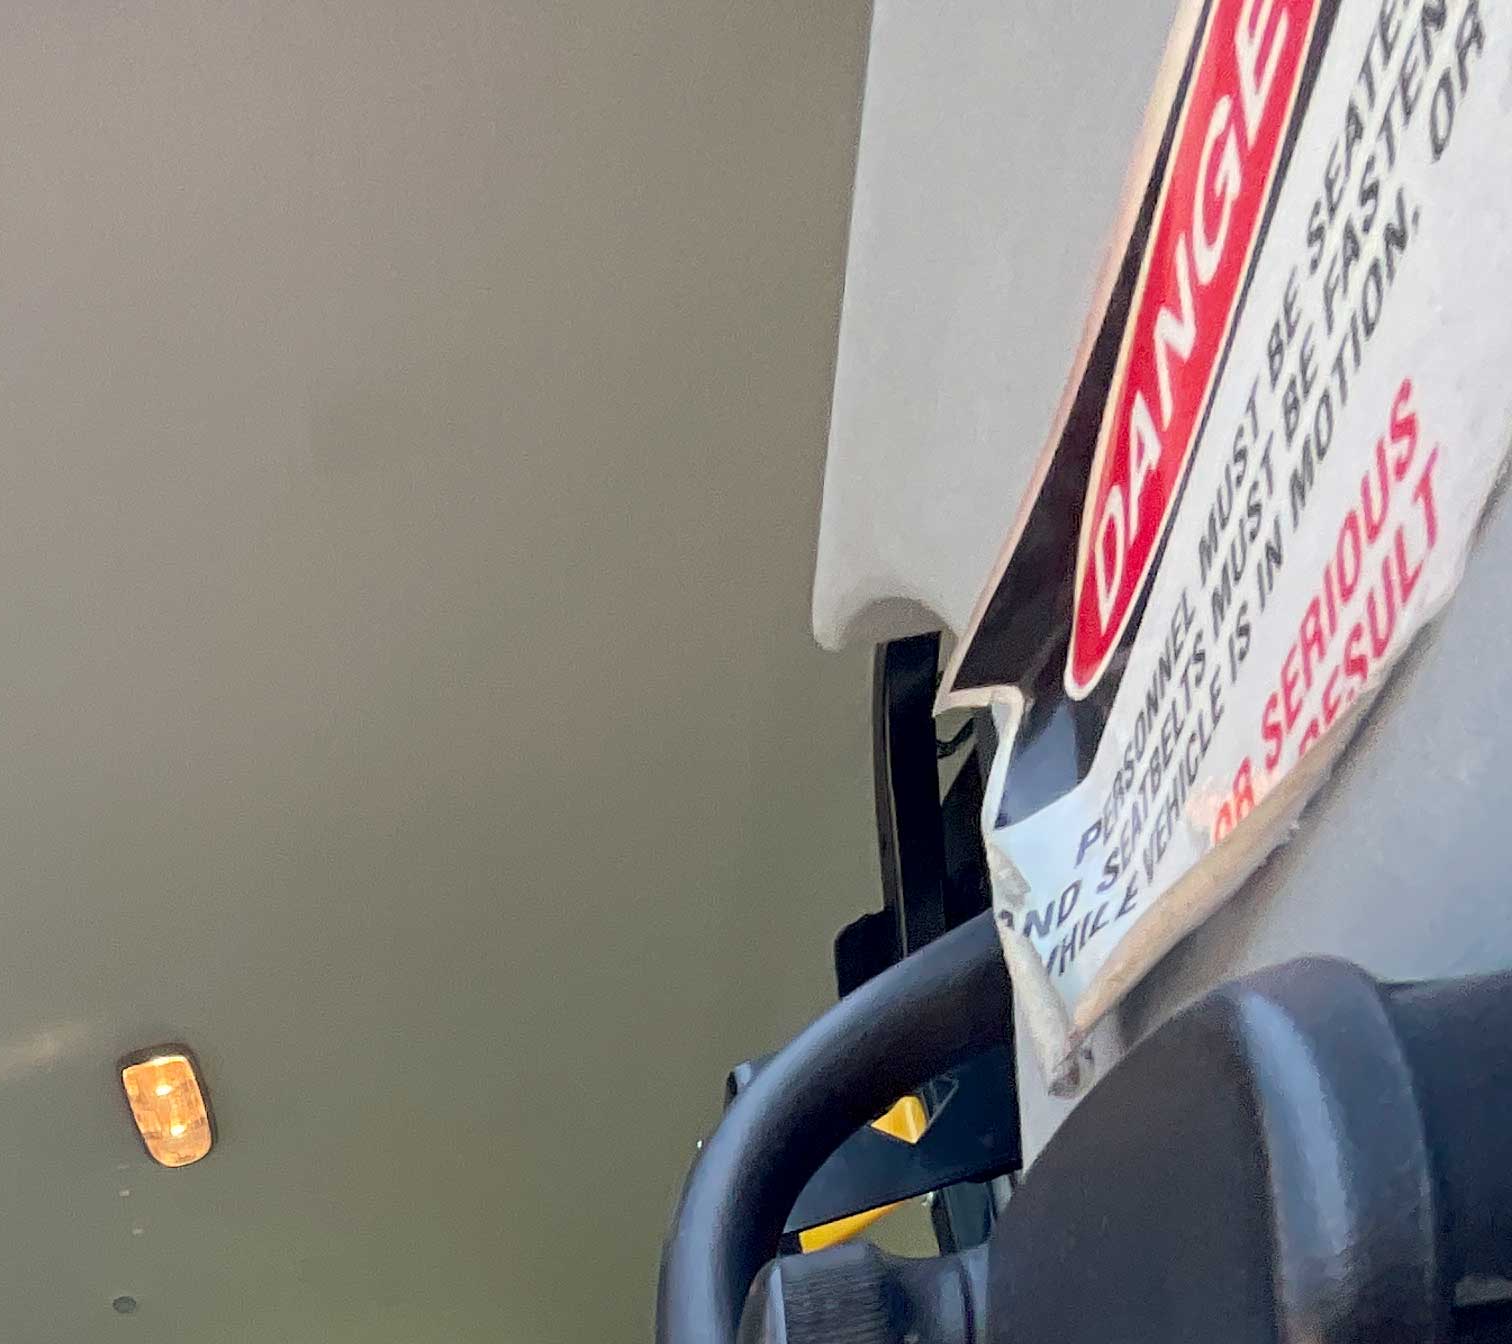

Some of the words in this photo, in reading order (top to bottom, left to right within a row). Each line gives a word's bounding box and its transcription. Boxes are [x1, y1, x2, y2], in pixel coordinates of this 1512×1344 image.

[1074, 588, 1196, 870] PERSONNEL
[1199, 373, 1260, 586] MUST
[1268, 265, 1302, 391] BE
[1307, 0, 1410, 275] SEATE
[1096, 629, 1206, 894] SEATBELTS
[1211, 431, 1274, 643] MUST
[1283, 322, 1318, 450] BE
[1142, 664, 1224, 884] VEHICLE
[1228, 600, 1251, 682] IS
[1257, 515, 1284, 613] IN
[1429, 0, 1486, 163] OR
[1261, 377, 1418, 773] SERIOUS
